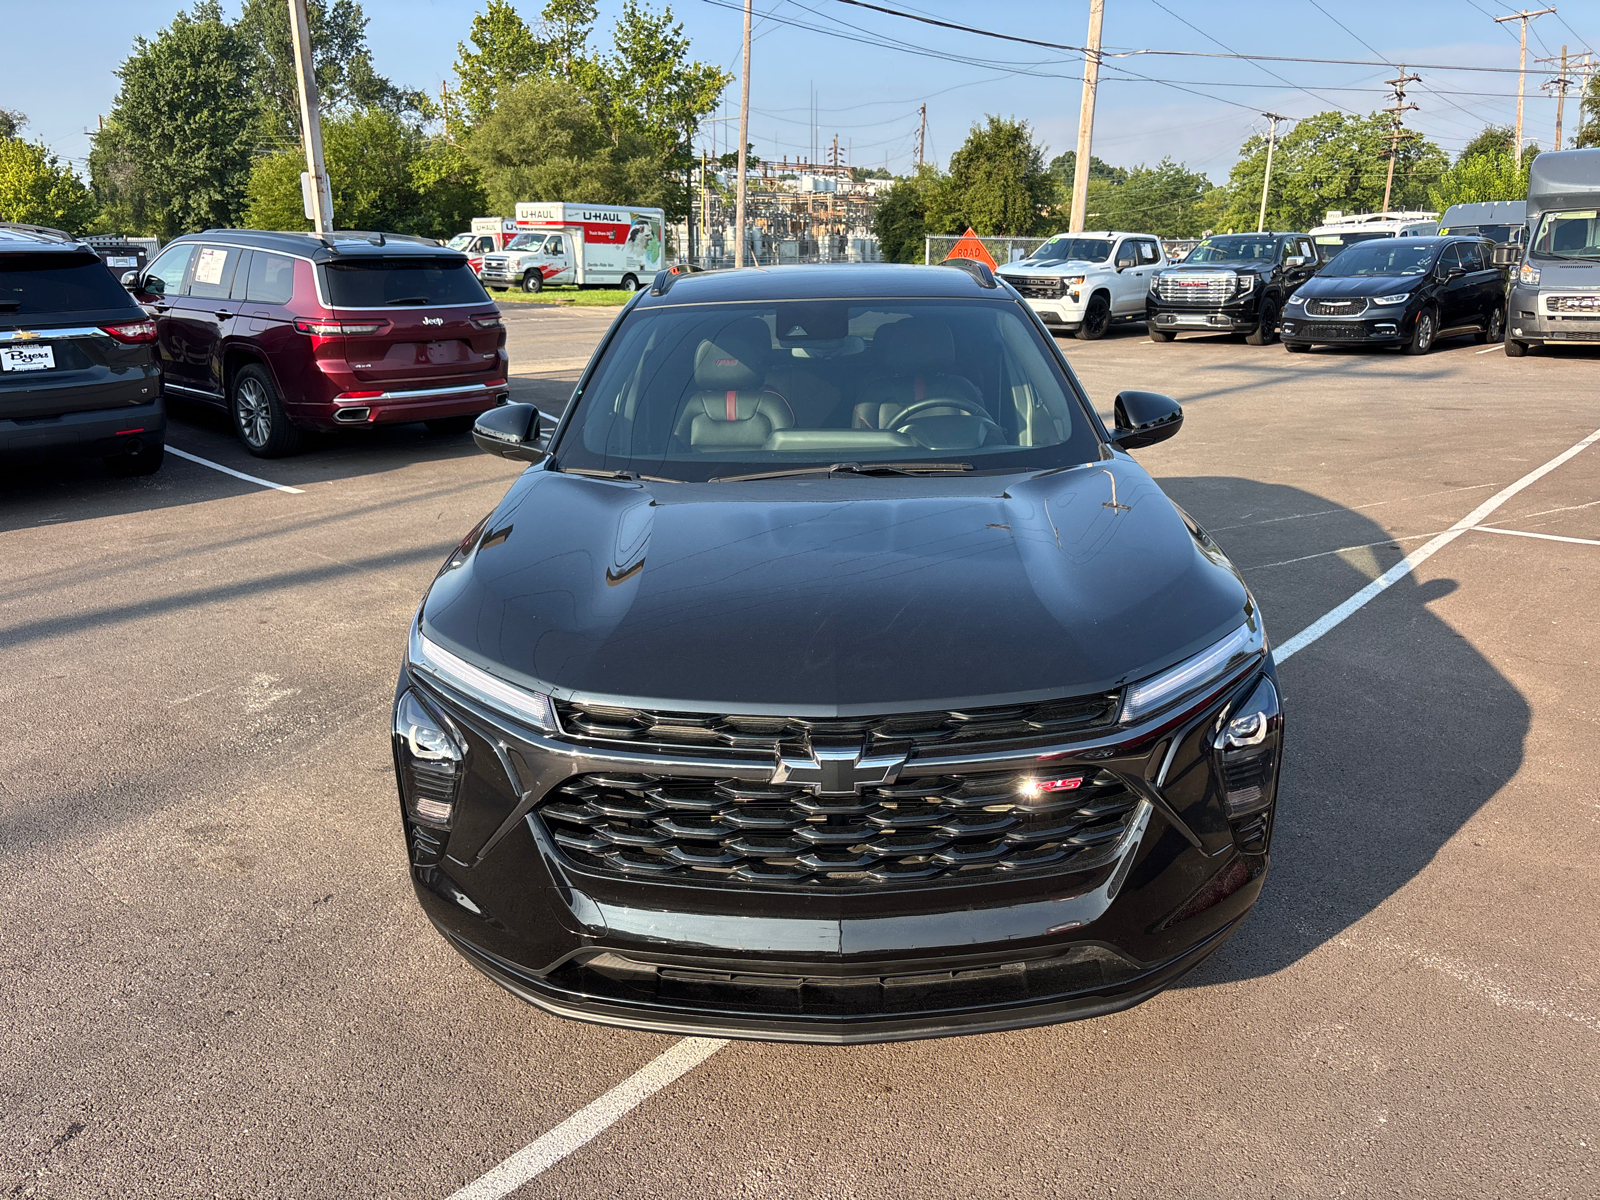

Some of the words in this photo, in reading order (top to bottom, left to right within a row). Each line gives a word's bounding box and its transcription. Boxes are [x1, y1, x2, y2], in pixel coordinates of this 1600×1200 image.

[957, 247, 981, 258] ROAD
[422, 316, 444, 326] Jeep
[4, 350, 49, 363] Byers
[1036, 776, 1083, 792] RS
